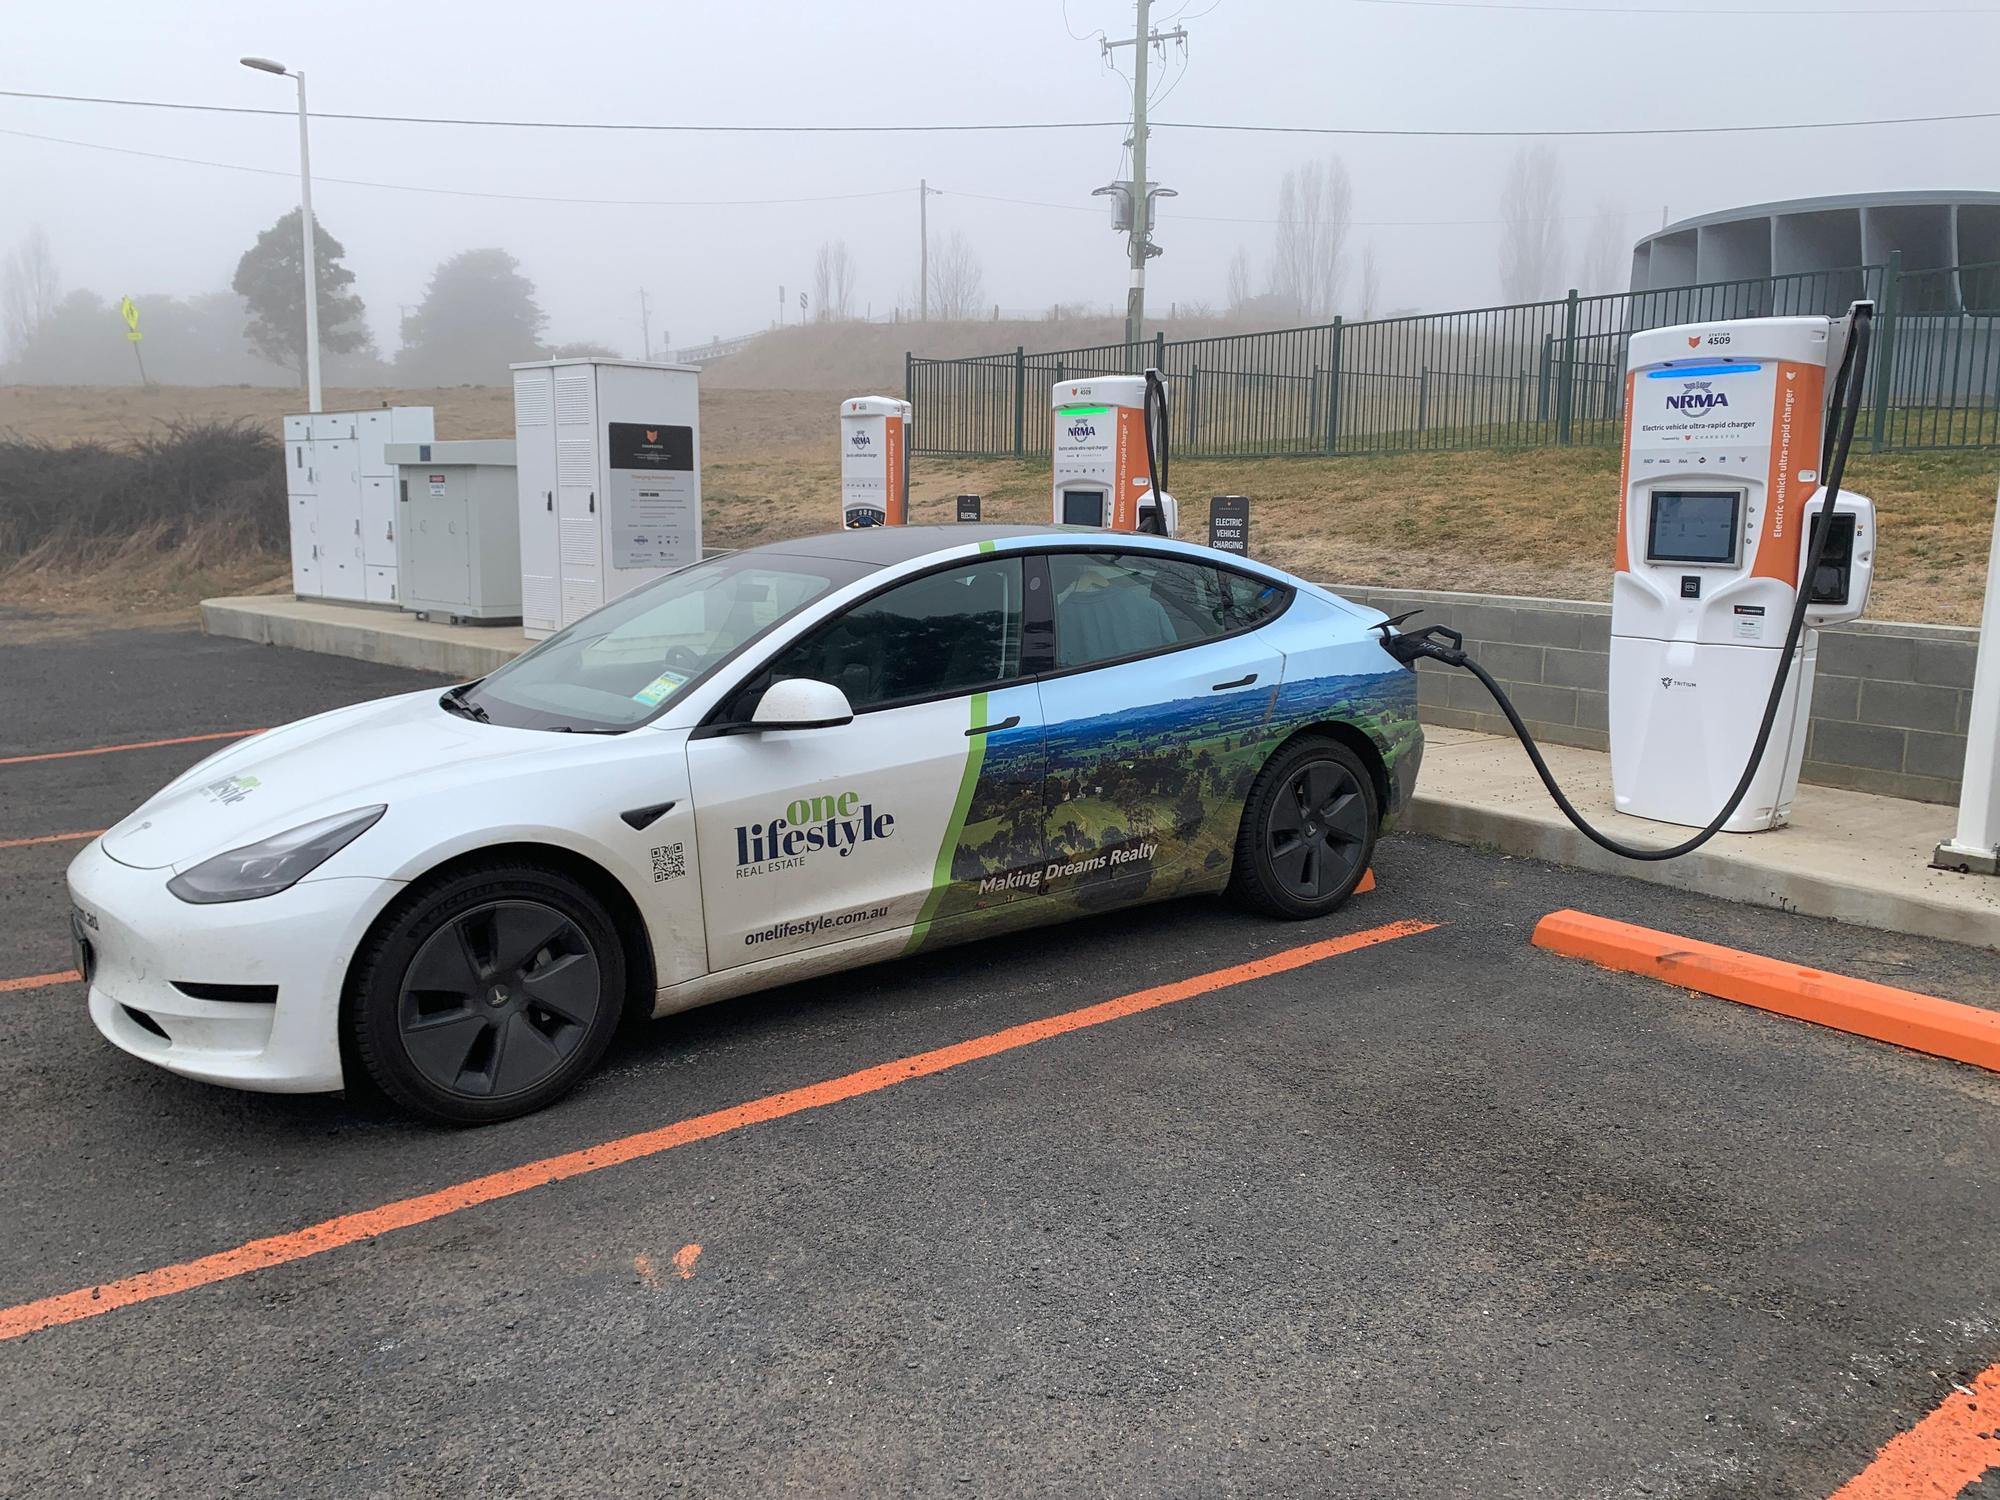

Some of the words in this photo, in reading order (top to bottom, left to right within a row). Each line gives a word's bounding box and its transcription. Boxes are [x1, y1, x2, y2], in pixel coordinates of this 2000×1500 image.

[1708, 337, 1731, 345] 4509
[1666, 393, 1728, 409] NRMA
[1781, 388, 1794, 423] charger
[1068, 426, 1095, 436] NRMA
[1689, 421, 1726, 429] ultra-rapid
[1727, 421, 1755, 429] charger
[851, 437, 871, 445] NRMA
[1120, 424, 1128, 447] charger
[1778, 424, 1791, 471] ultra-rapid
[1776, 472, 1786, 504] vehicle
[960, 511, 977, 519] ELECTRIC
[1215, 518, 1243, 527] ELECTRIC
[1773, 505, 1784, 538] Electric
[1216, 529, 1240, 538] VEHICLE
[1212, 540, 1244, 550] CHARGING
[1419, 641, 1443, 653] HPC
[786, 791, 859, 826] one
[734, 804, 895, 857] lifestyle
[736, 865, 764, 879] REAL
[768, 856, 806, 873] ESTATE
[978, 870, 1042, 895] Making
[1045, 854, 1107, 881] Dreams
[1109, 843, 1158, 866] Realty
[744, 906, 889, 946] onelifestyle.com.au
